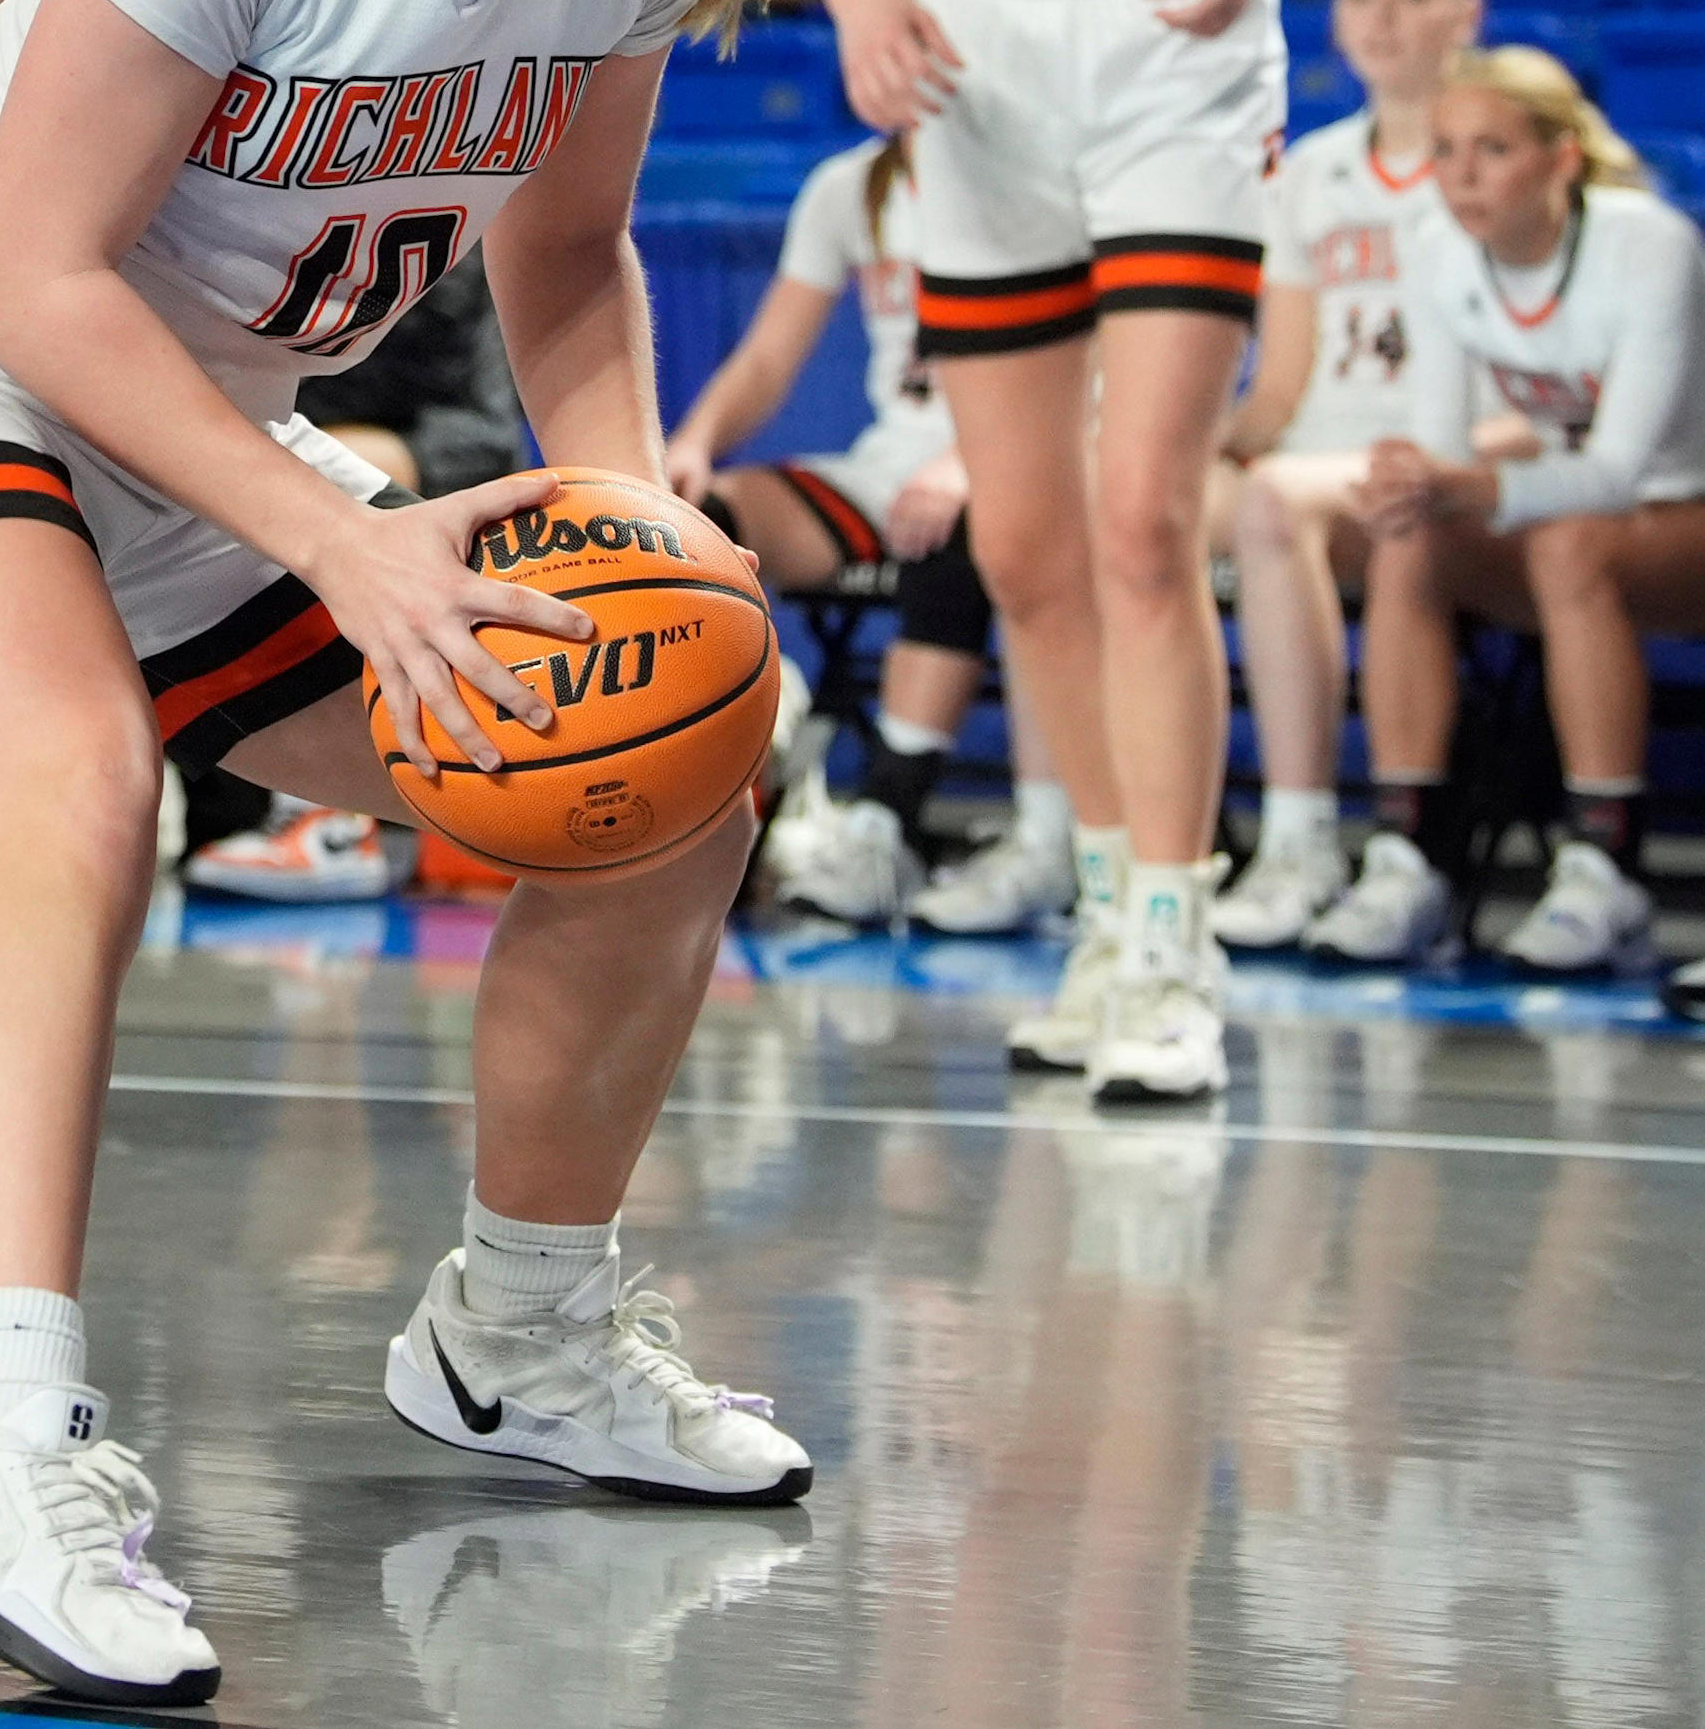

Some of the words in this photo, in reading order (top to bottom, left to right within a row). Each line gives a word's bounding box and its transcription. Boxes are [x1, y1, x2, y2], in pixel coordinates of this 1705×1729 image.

[183, 54, 607, 191] RICHLAN
[243, 204, 468, 358] 10
[542, 560, 583, 574] GAME
[588, 556, 623, 566] BALL
[659, 619, 705, 647] NXT
